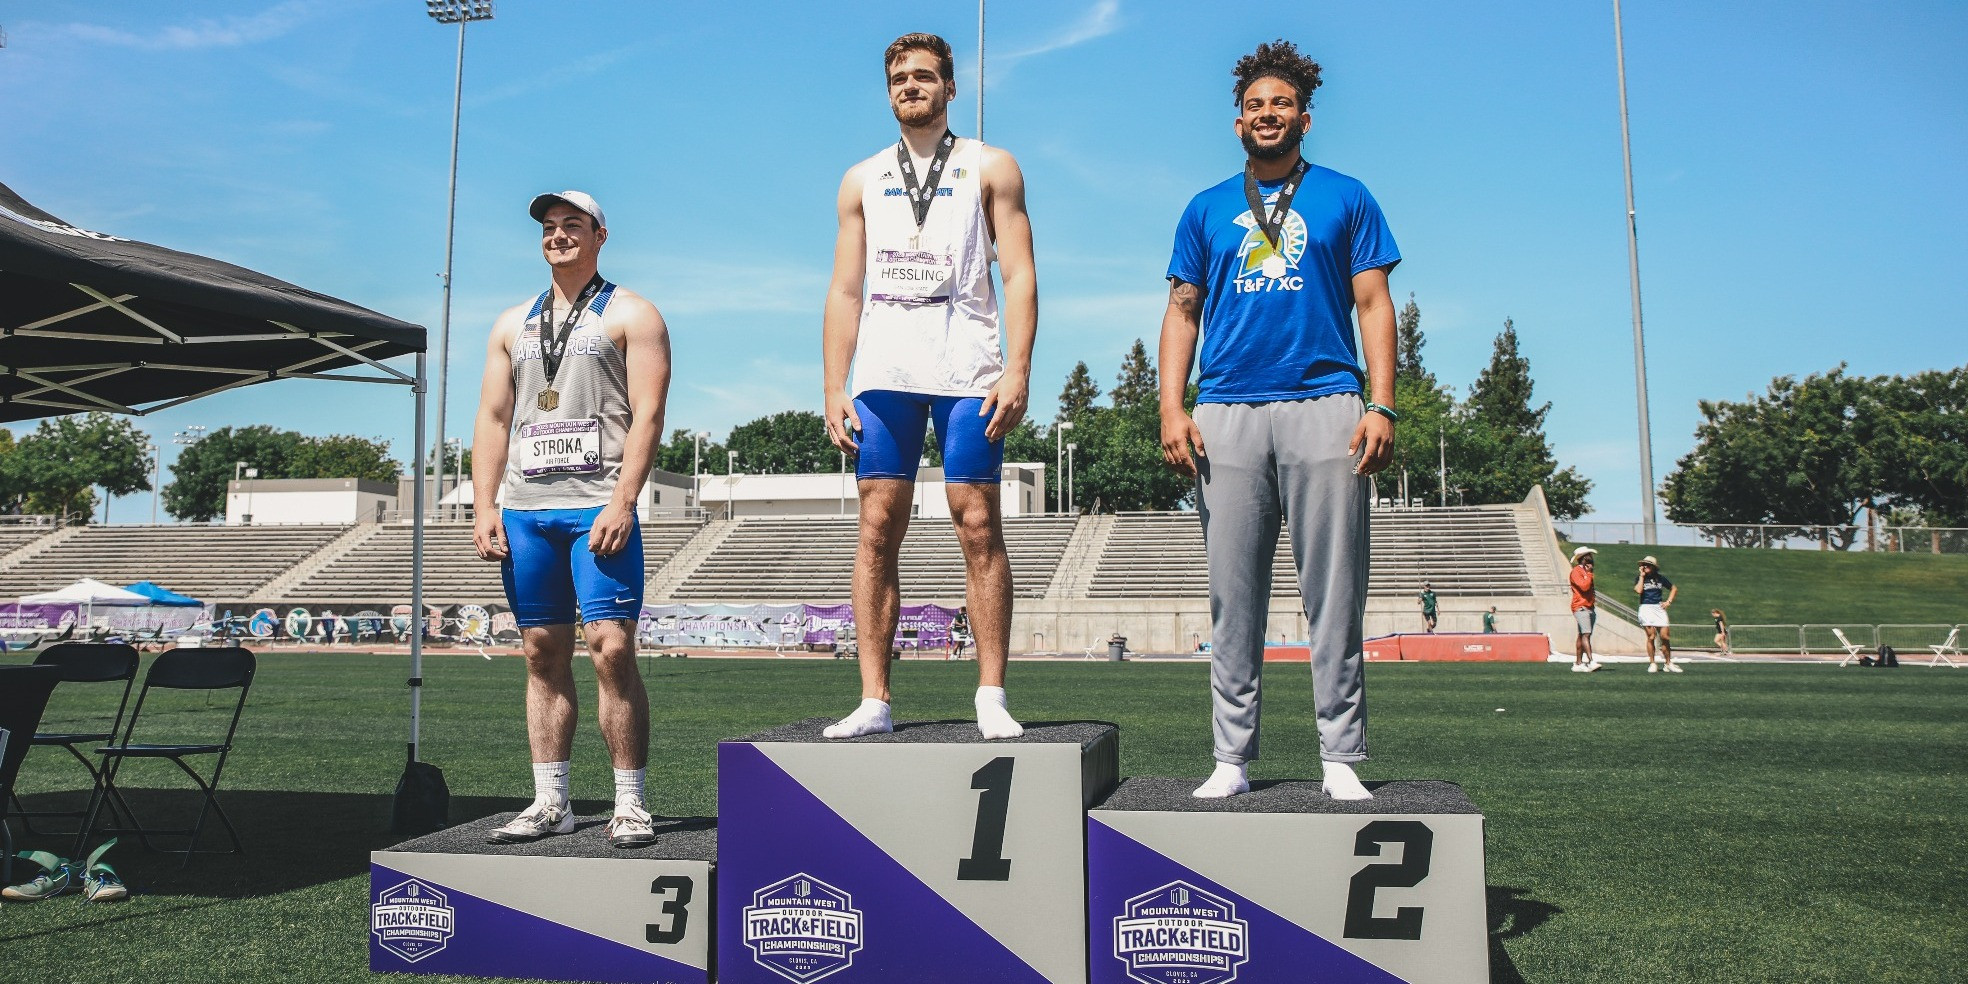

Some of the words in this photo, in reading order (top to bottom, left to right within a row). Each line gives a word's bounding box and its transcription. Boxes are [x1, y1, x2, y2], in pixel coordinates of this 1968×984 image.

[884, 187, 902, 197] SAN
[881, 268, 944, 282] HESSLING
[533, 437, 583, 457] STROKA
[957, 756, 1015, 881] 1
[1343, 820, 1434, 940] 2
[767, 898, 811, 906] MOUNTAIN
[813, 899, 837, 908] WEST
[645, 875, 693, 944] 3
[782, 909, 823, 917] OUTDOOR
[1141, 907, 1190, 916] MOUNTAIN
[1192, 908, 1219, 918] WEST
[1157, 919, 1204, 927] OUTDOOR
[386, 929, 439, 938] CHAMPIONSHIPS
[764, 940, 842, 952] CHAMPIONSHIPS
[1138, 952, 1225, 965] CHAMPIONSHIPS
